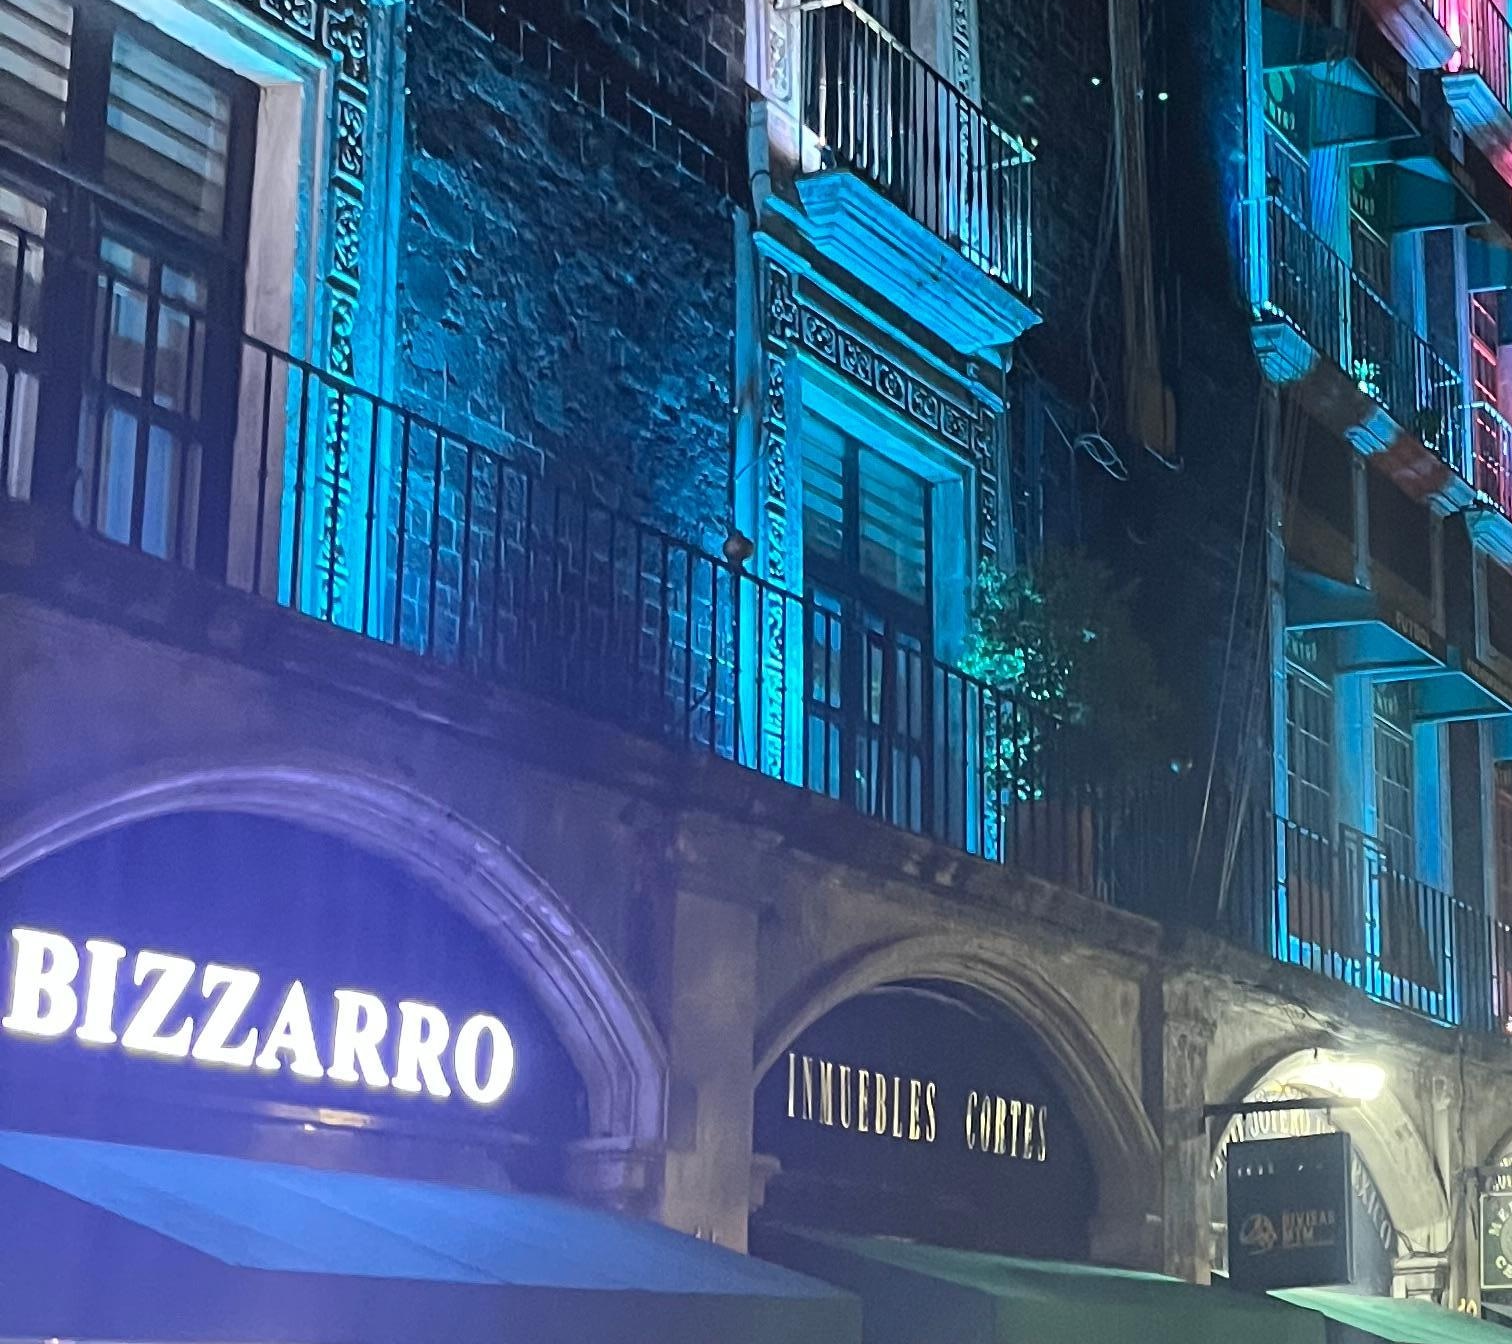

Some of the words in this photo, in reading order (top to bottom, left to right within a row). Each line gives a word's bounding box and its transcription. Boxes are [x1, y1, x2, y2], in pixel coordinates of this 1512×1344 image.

[3, 927, 515, 1104] BIZZARRO
[788, 1053, 936, 1142] INMUEBLES
[966, 1090, 1047, 1161] CORTES
